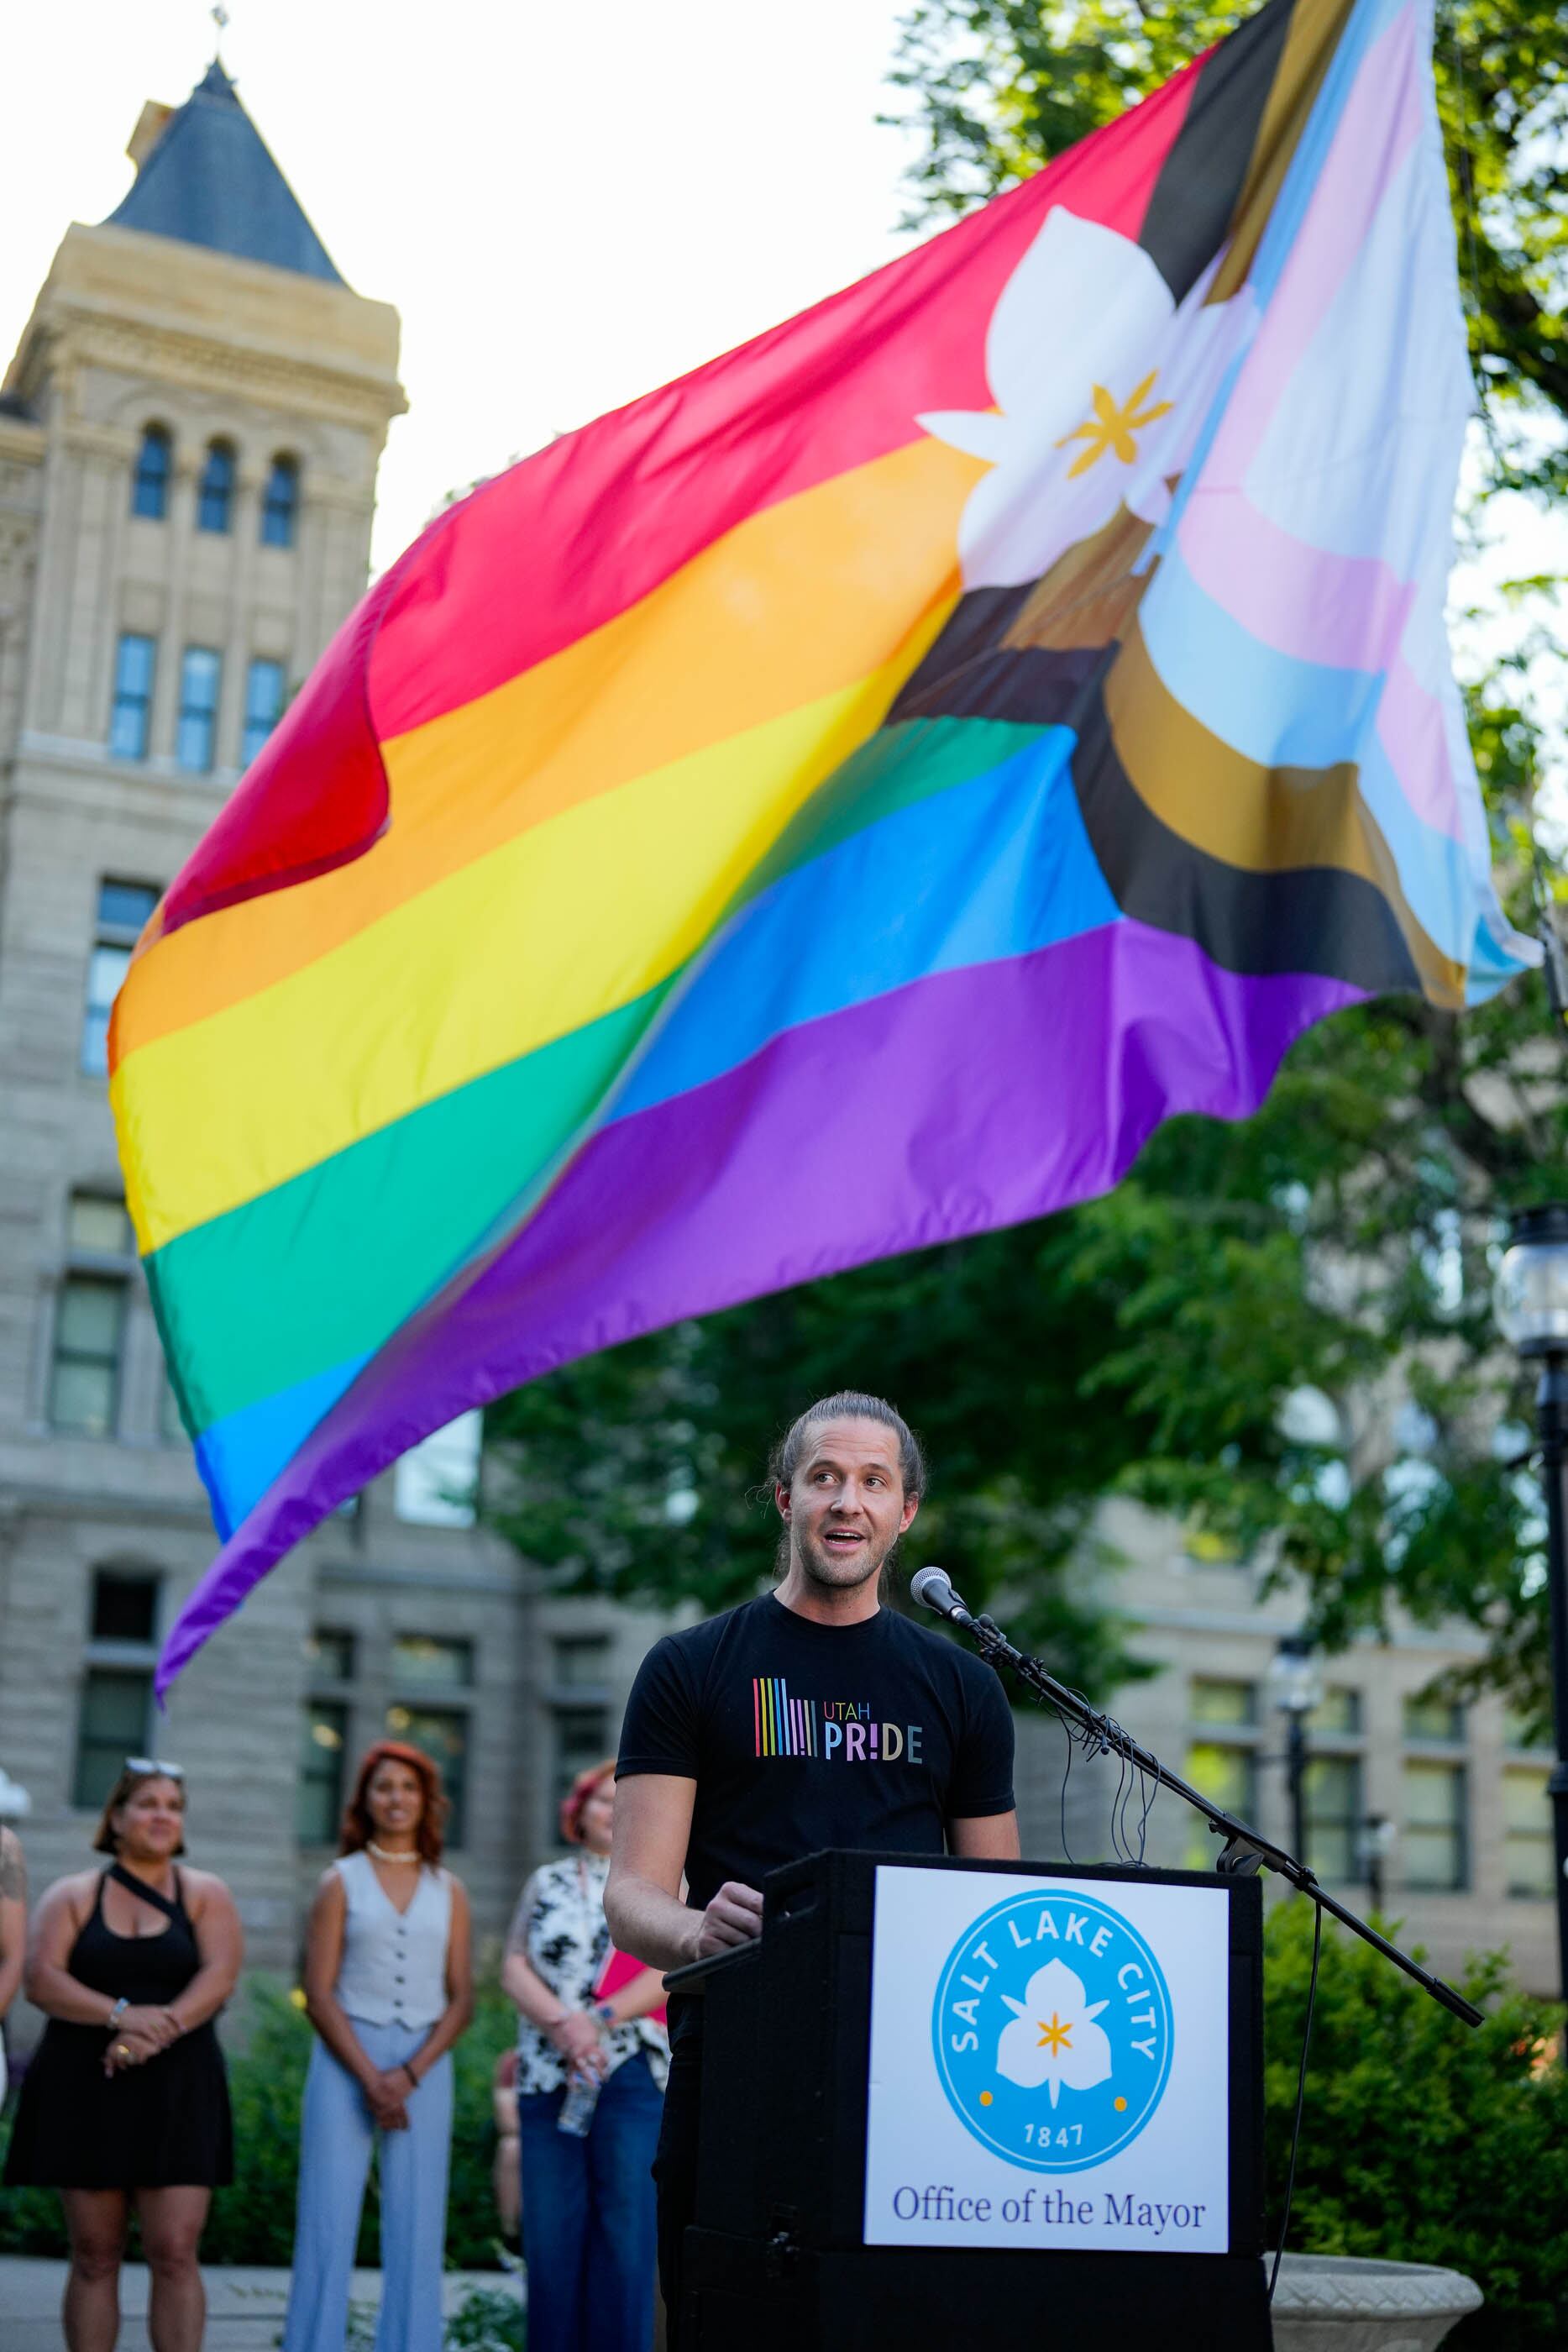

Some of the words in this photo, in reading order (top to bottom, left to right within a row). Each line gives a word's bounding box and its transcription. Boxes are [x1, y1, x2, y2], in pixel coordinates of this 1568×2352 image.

[824, 1701, 870, 1720] UTAH
[952, 1940, 999, 2052] SALT
[1008, 1910, 1114, 1958] LAKE
[1117, 1962, 1157, 2061] CITY
[1024, 2124, 1083, 2148] 1847
[893, 2186, 991, 2223] Office
[1002, 2189, 1036, 2223] of
[1043, 2189, 1093, 2225] the
[1104, 2192, 1207, 2236] Mayor
